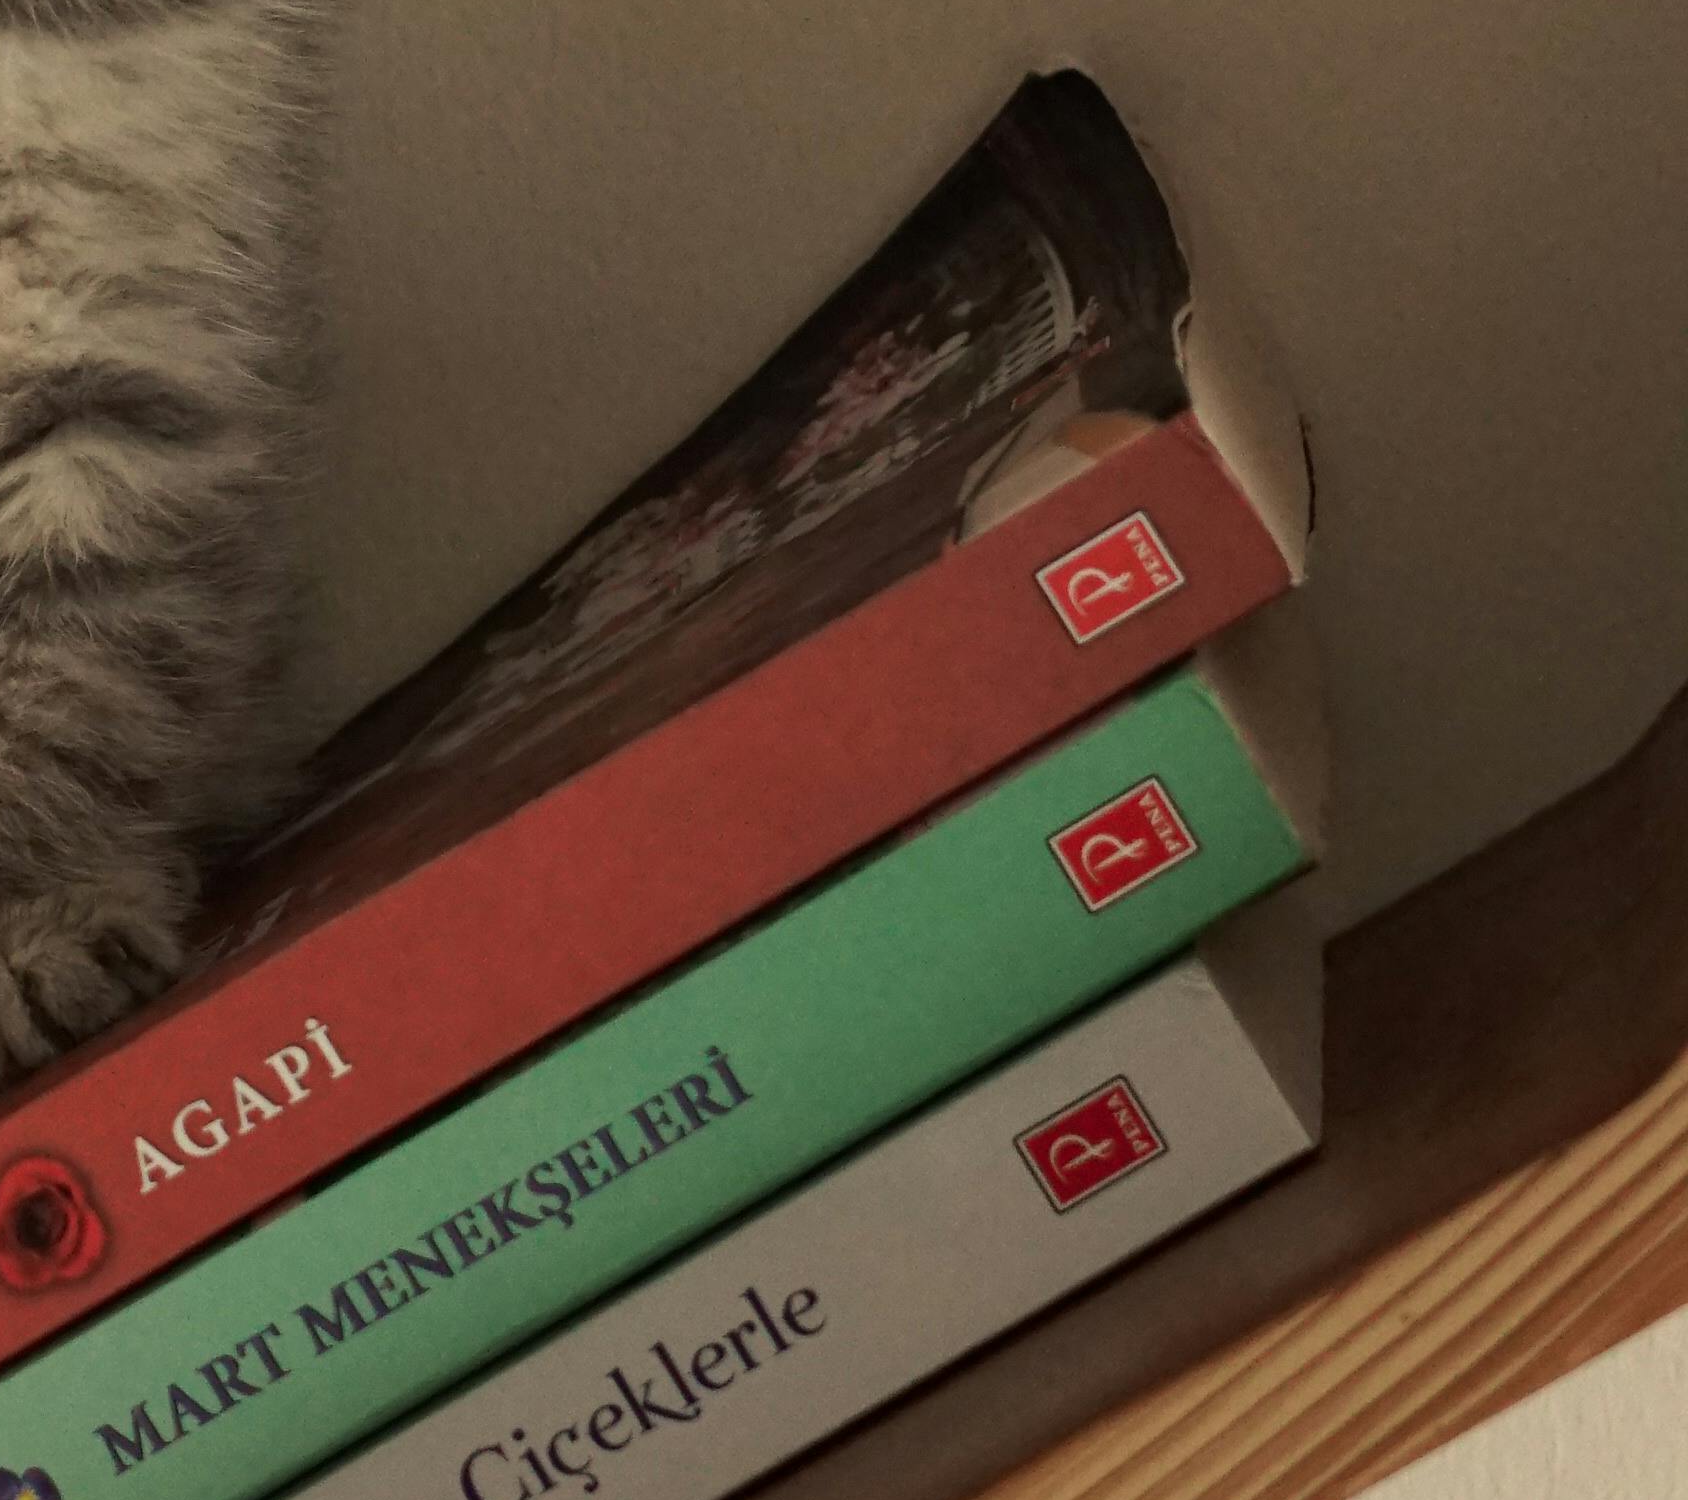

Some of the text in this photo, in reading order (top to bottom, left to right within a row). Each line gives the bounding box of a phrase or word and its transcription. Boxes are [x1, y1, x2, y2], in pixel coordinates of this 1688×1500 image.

[1126, 526, 1170, 587] PENA
[1138, 792, 1183, 853] PENA
[129, 1016, 353, 1194] AGAPİ
[1108, 1093, 1150, 1153] PENA
[94, 1045, 756, 1477] MART MENEKŞELERİ
